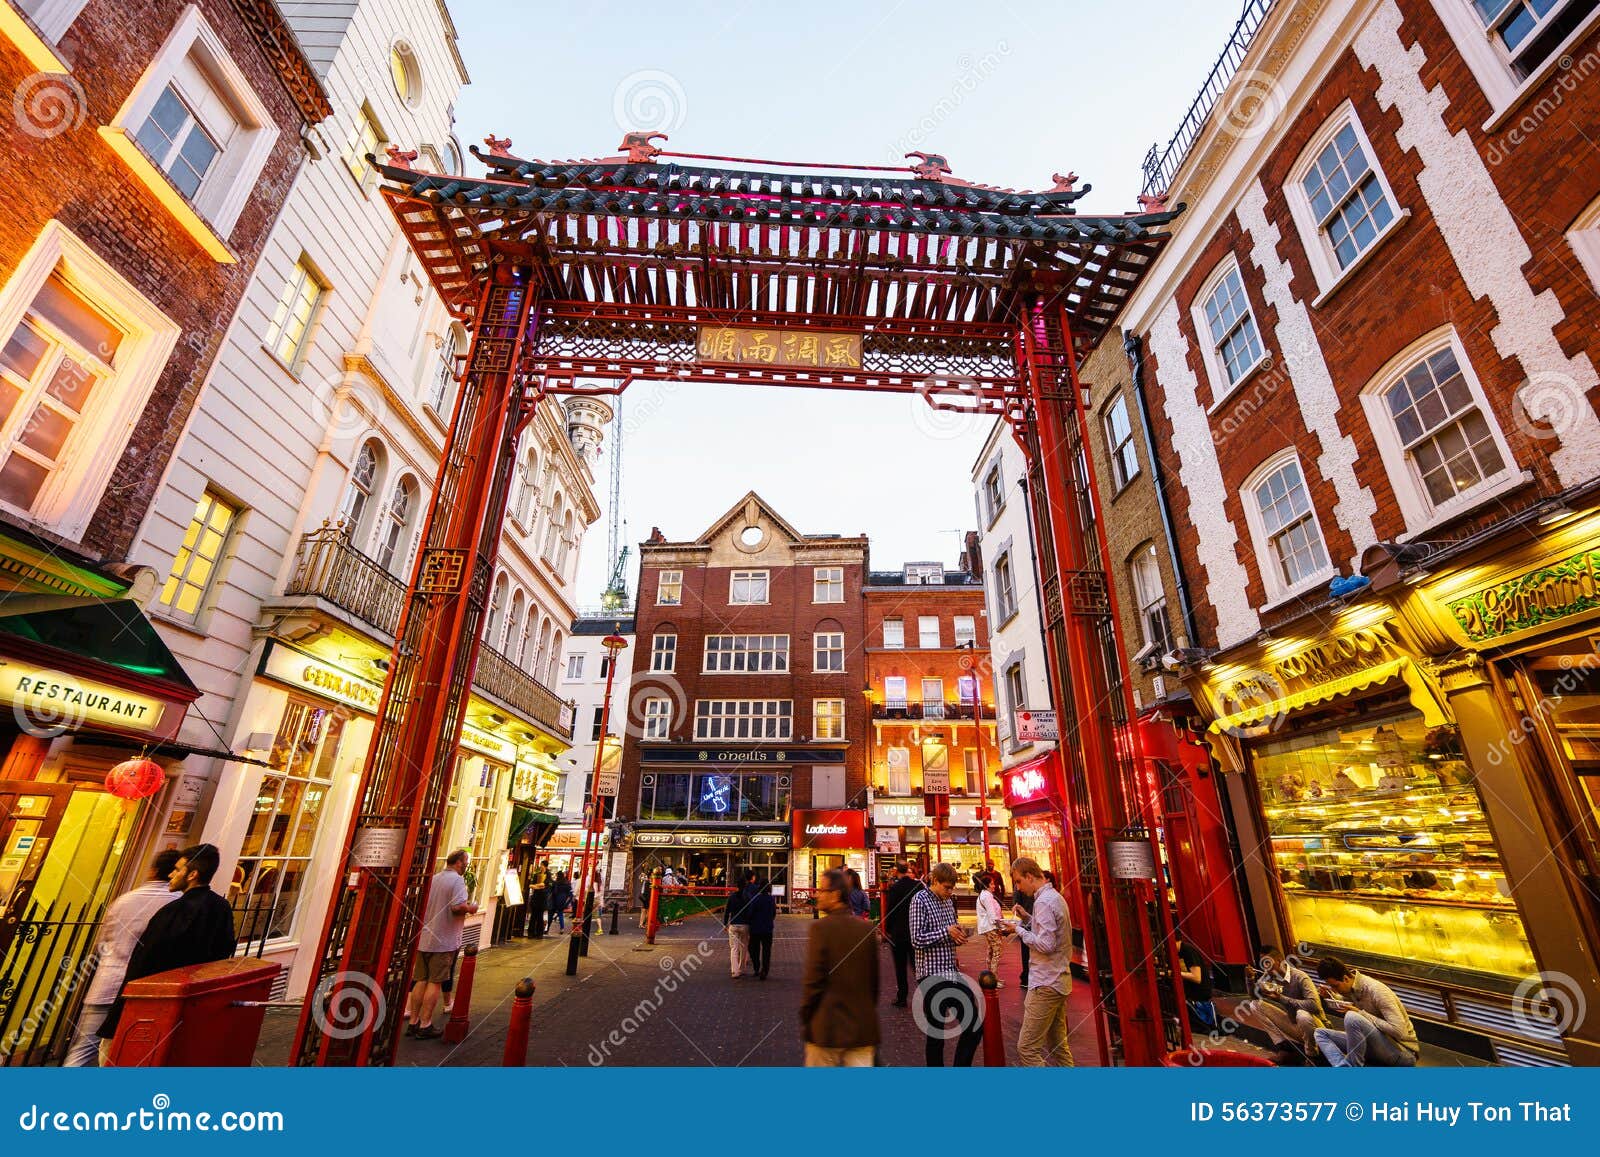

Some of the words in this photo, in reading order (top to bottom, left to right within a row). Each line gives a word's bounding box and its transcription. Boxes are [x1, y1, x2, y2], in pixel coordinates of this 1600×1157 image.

[1276, 620, 1402, 681] KOWLOON
[16, 677, 147, 718] RESTAURANT
[806, 824, 847, 834] Ladbrokes
